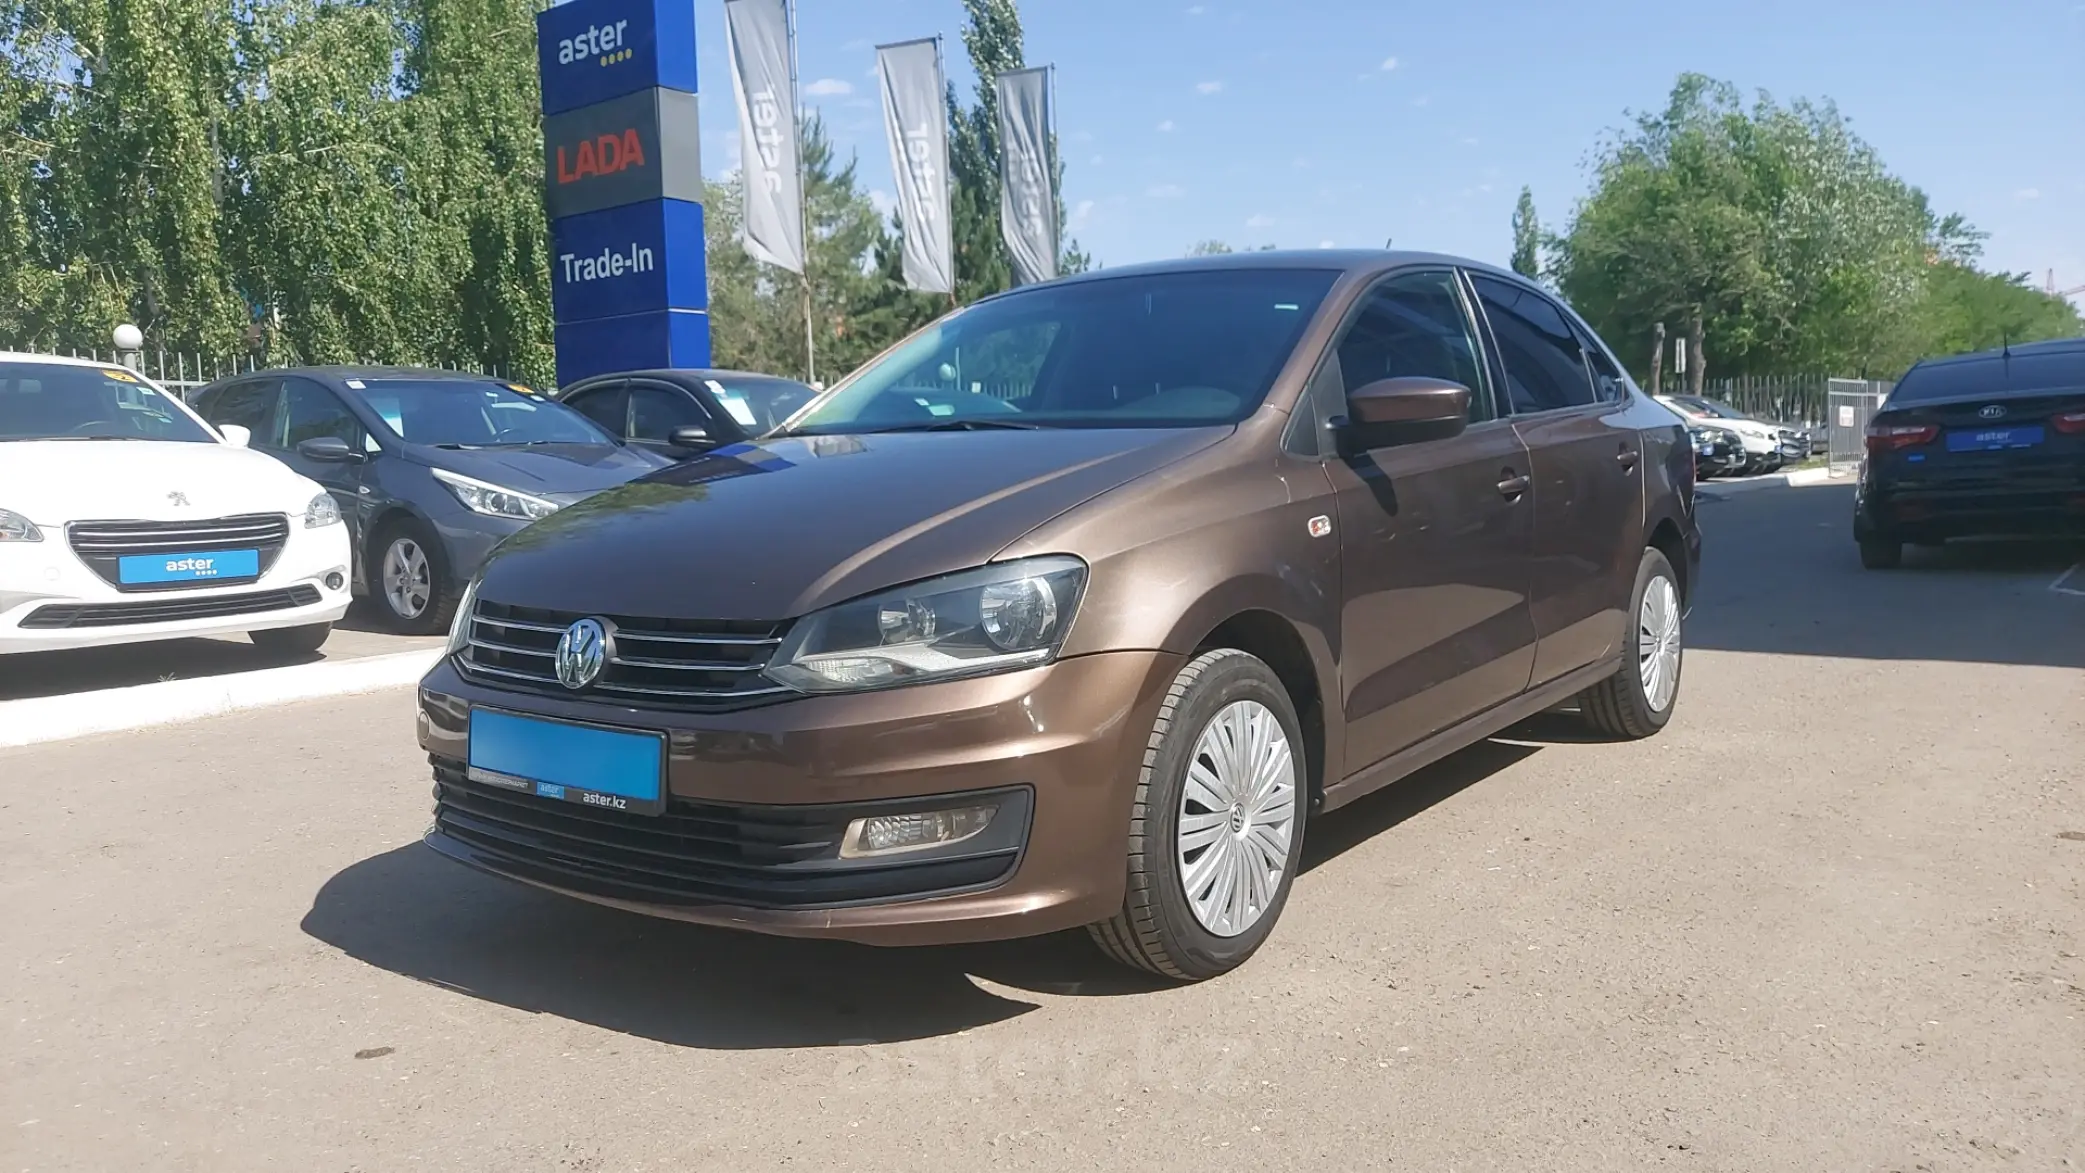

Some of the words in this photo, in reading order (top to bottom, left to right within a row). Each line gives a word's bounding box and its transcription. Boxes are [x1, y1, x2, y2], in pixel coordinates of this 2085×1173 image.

[559, 19, 627, 64] aster
[557, 128, 645, 184] LADA
[560, 242, 653, 283] Trade-In
[1976, 431, 2010, 441] aster
[165, 557, 214, 571] aster
[582, 792, 626, 809] aster.kz
